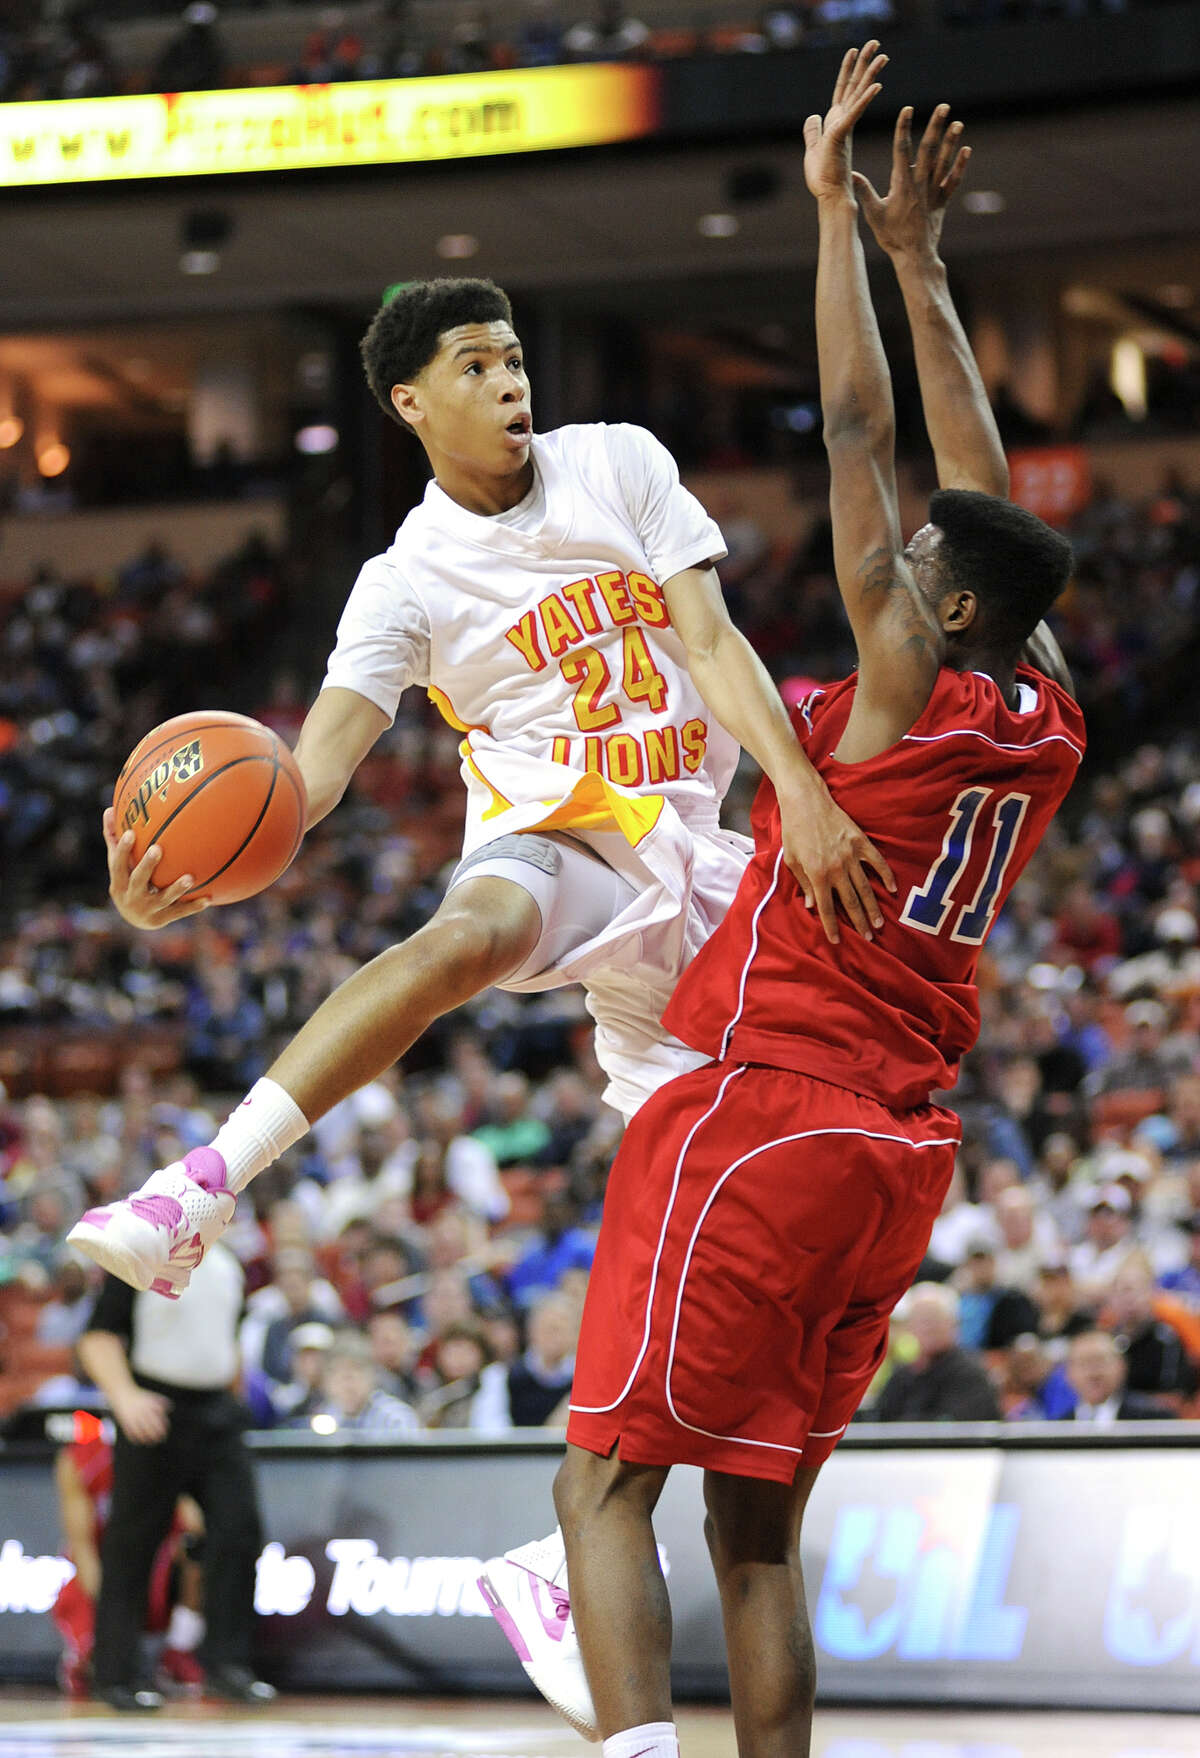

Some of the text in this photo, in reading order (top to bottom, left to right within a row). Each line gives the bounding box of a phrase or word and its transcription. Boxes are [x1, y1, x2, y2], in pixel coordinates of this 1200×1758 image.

[504, 569, 672, 673] YATES
[559, 625, 669, 733] 24
[898, 786, 1032, 946] 11
